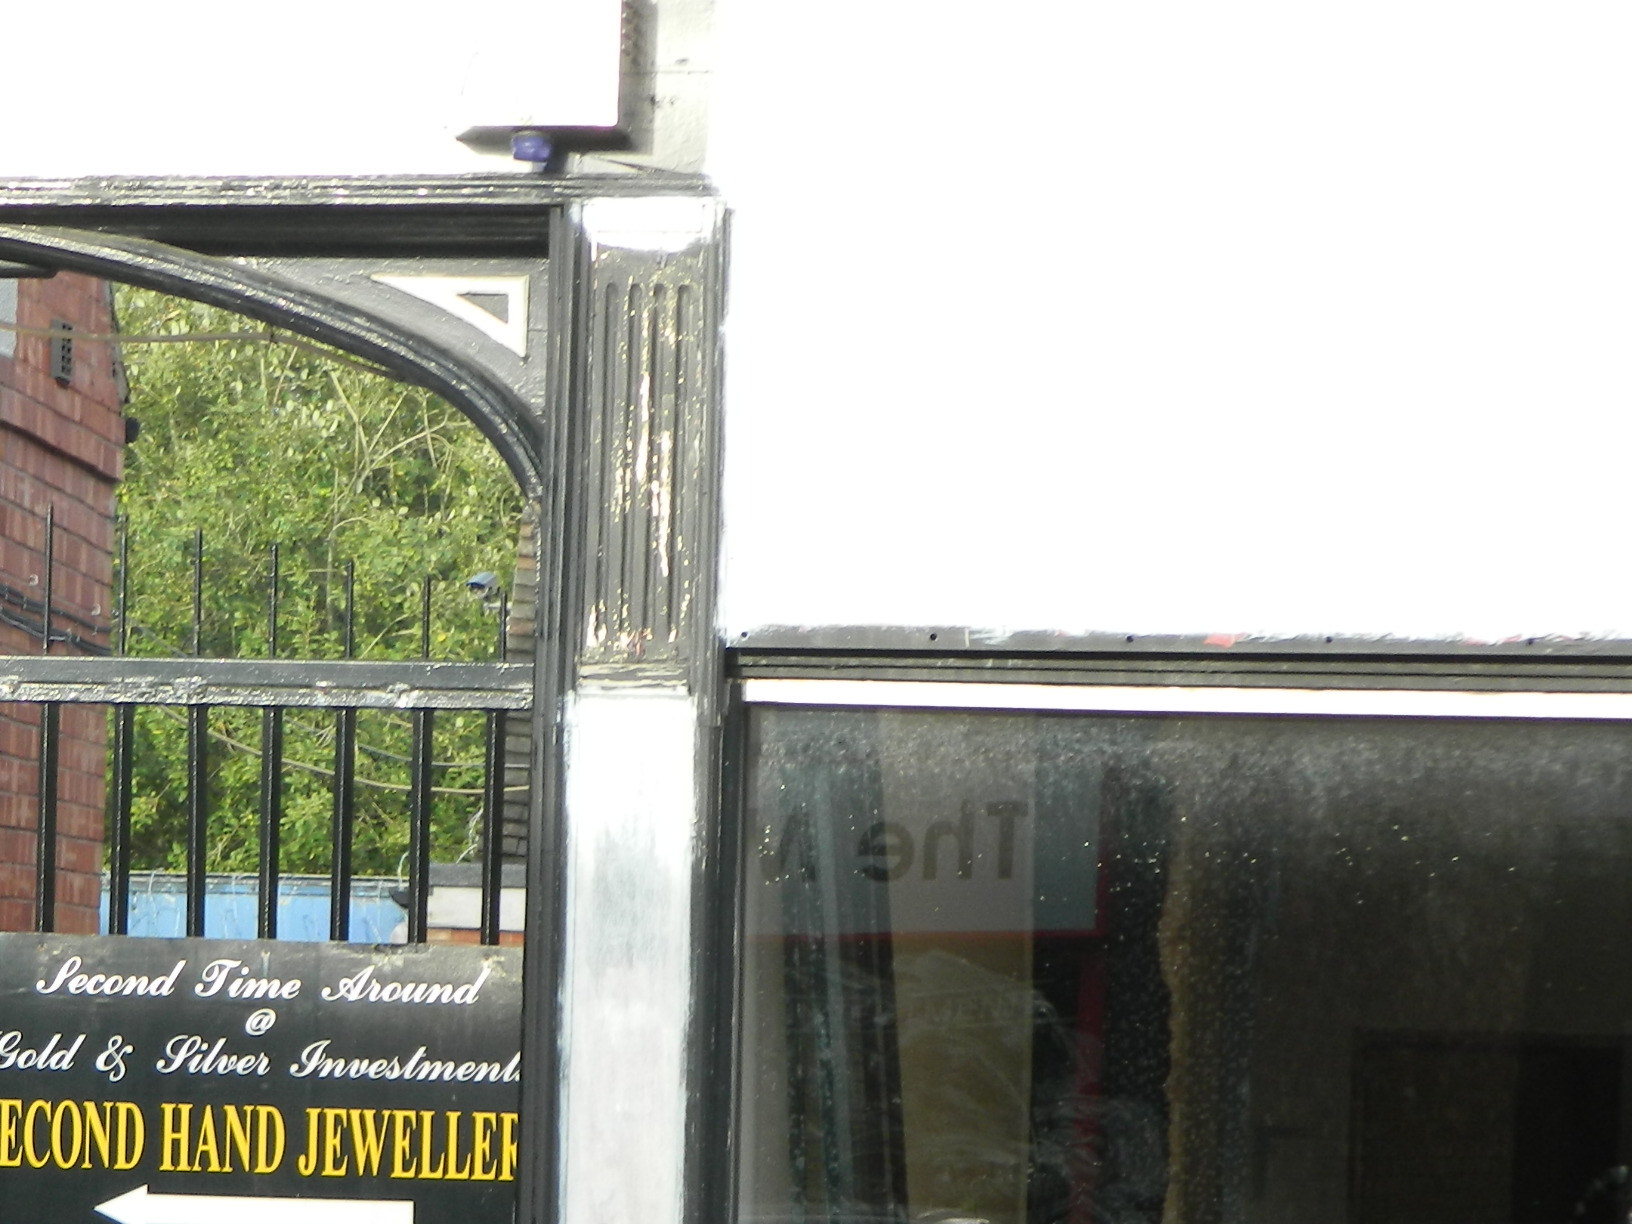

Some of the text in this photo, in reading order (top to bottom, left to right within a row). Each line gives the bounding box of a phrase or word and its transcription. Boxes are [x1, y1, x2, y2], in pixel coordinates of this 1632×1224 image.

[36, 955, 486, 1005] Second Time Around
[244, 1008, 277, 1036] @
[95, 1035, 134, 1082] &
[156, 1034, 271, 1076] Silver
[289, 1039, 521, 1083] Investment
[158, 1102, 286, 1175] HAND
